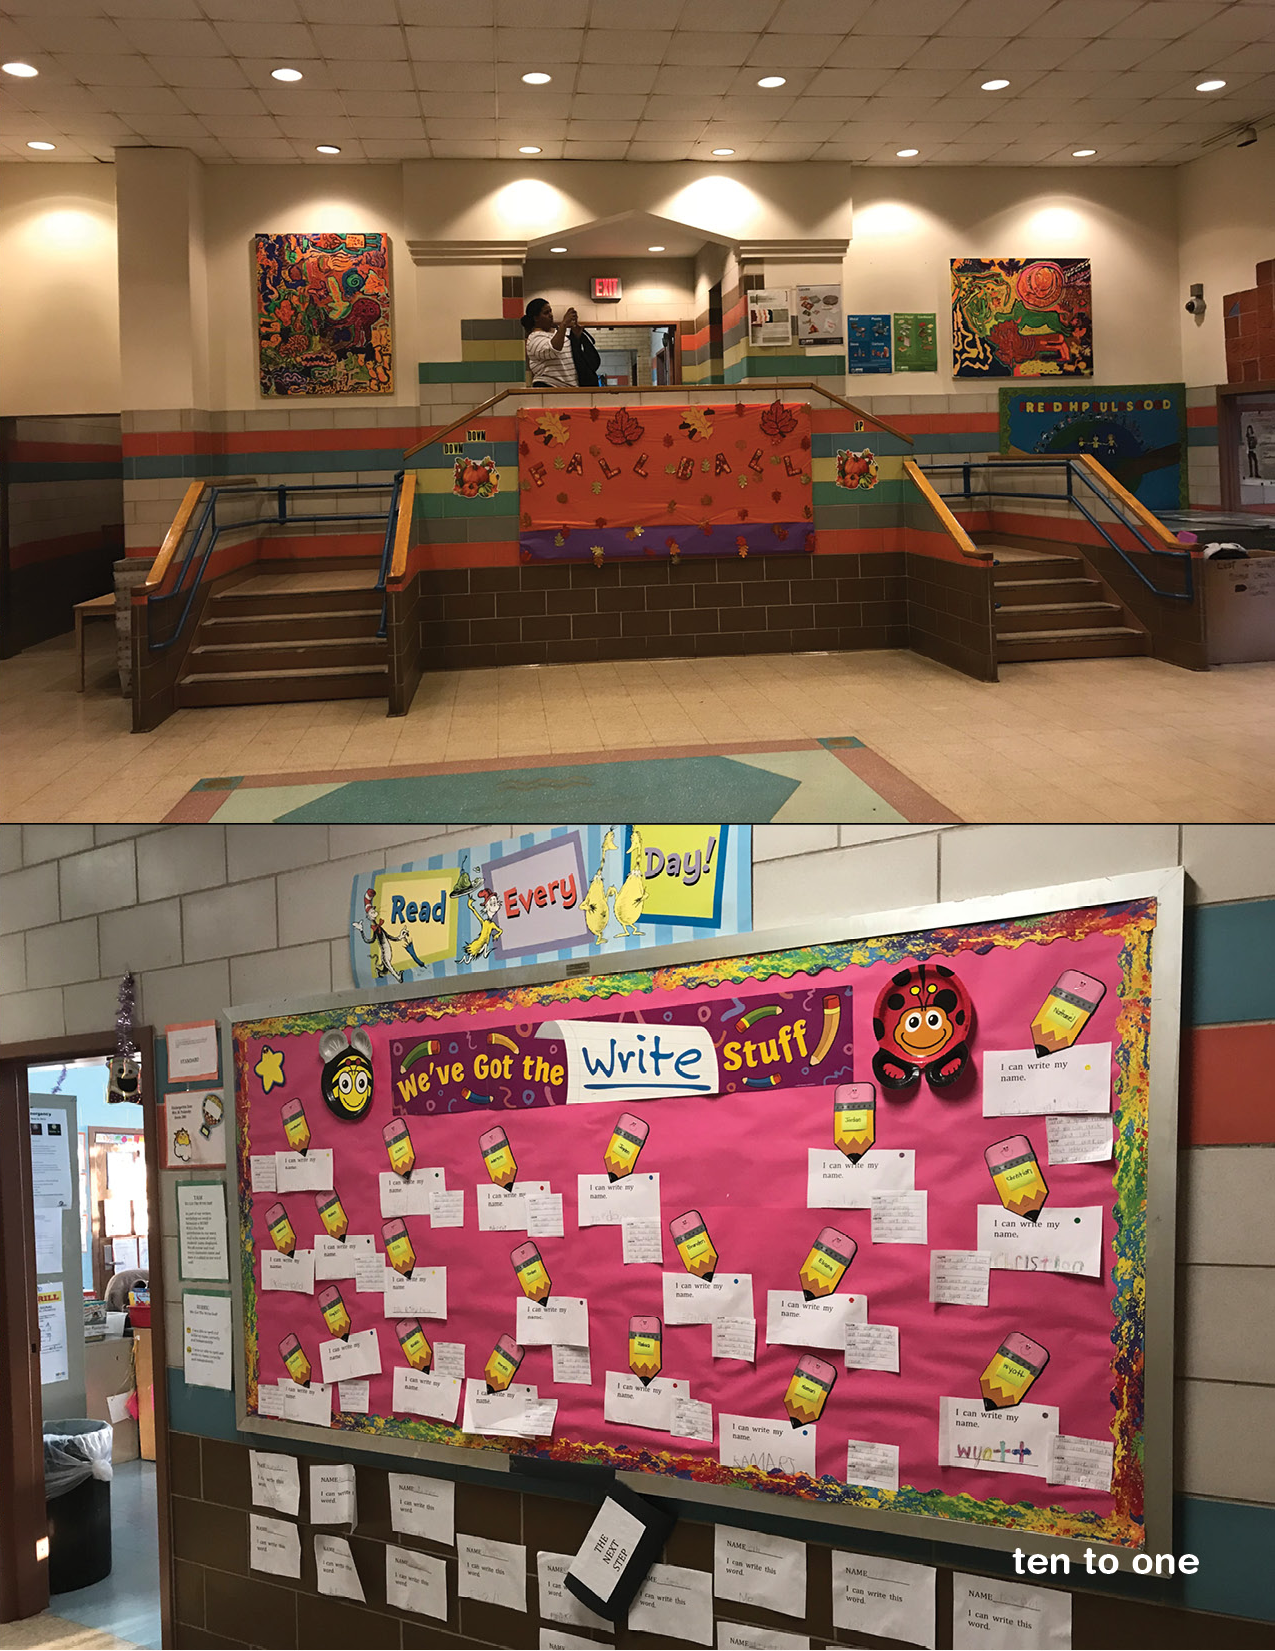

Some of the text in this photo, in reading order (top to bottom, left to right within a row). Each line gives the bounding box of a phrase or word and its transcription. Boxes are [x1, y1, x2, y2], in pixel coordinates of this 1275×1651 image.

[596, 279, 618, 296] EXIT
[855, 421, 863, 430] UP
[468, 431, 486, 441] DOWN
[445, 444, 463, 454] DOWN
[529, 449, 802, 487] FALL BALL
[391, 836, 717, 926] Read Every Day!
[396, 1019, 808, 1103] We've Got the Write Stuff
[1054, 1061, 1068, 1069] my
[1001, 1074, 1026, 1082] name.
[1020, 1220, 1042, 1228] write
[1047, 1221, 1060, 1229] my
[802, 1302, 819, 1311] write
[823, 1305, 833, 1313] my
[781, 1310, 801, 1318] name.
[981, 1412, 1002, 1420] write
[1006, 1414, 1019, 1424] my
[956, 1420, 979, 1428] name.
[733, 1433, 751, 1441] name.
[752, 1426, 770, 1434] write
[773, 1429, 783, 1437] my
[593, 1533, 609, 1554] THE
[603, 1539, 620, 1565] NEXT
[613, 1548, 628, 1572] STEP
[727, 1568, 744, 1576] word.
[746, 1561, 763, 1572] write
[765, 1566, 776, 1575] this
[846, 1596, 866, 1604] word.
[868, 1590, 887, 1599] write
[890, 1593, 903, 1602] this
[968, 1621, 990, 1631] word.
[992, 1615, 1013, 1626] write
[1017, 1619, 1032, 1629] this
